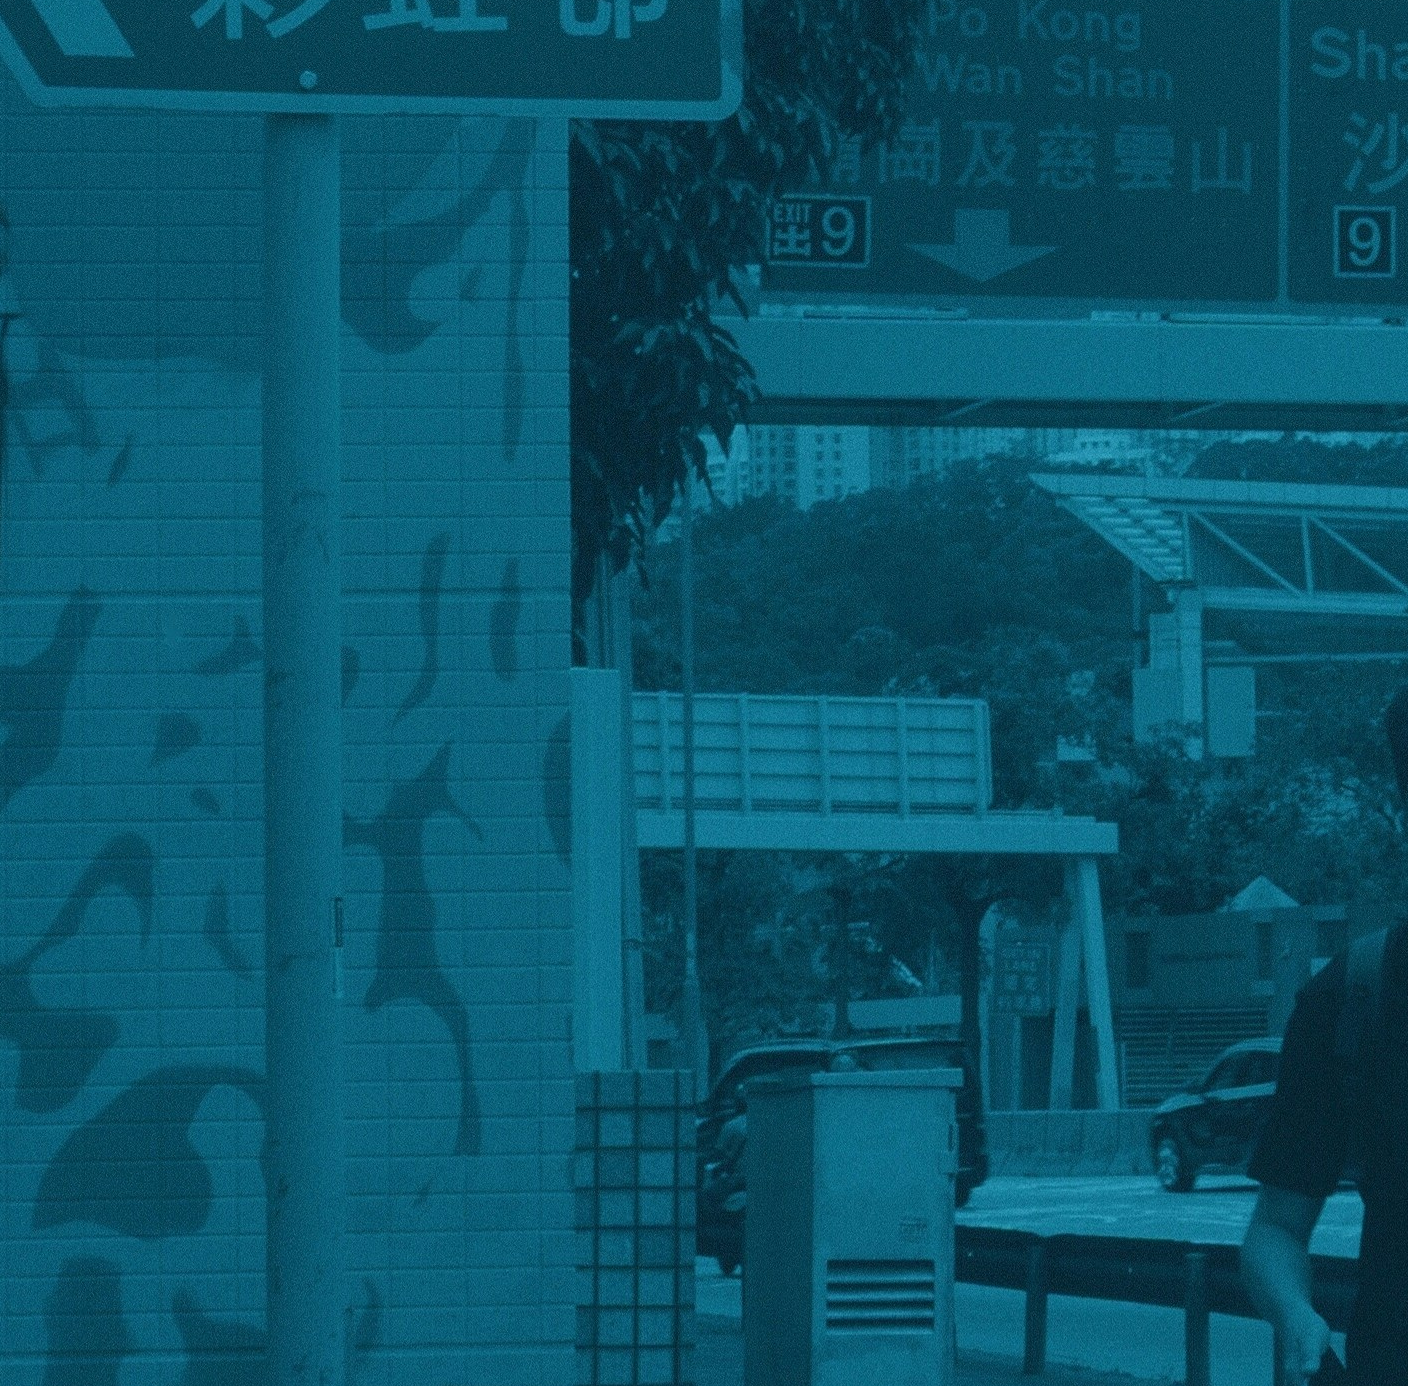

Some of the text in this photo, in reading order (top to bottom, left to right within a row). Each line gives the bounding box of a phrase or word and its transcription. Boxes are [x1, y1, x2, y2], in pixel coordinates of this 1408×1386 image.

[1019, 0, 1141, 53] Kong
[915, 51, 1172, 100] Wan Shan
[773, 204, 812, 224] EXIT
[821, 205, 856, 258] 9
[773, 225, 812, 256] 出
[1348, 215, 1382, 267] 9
